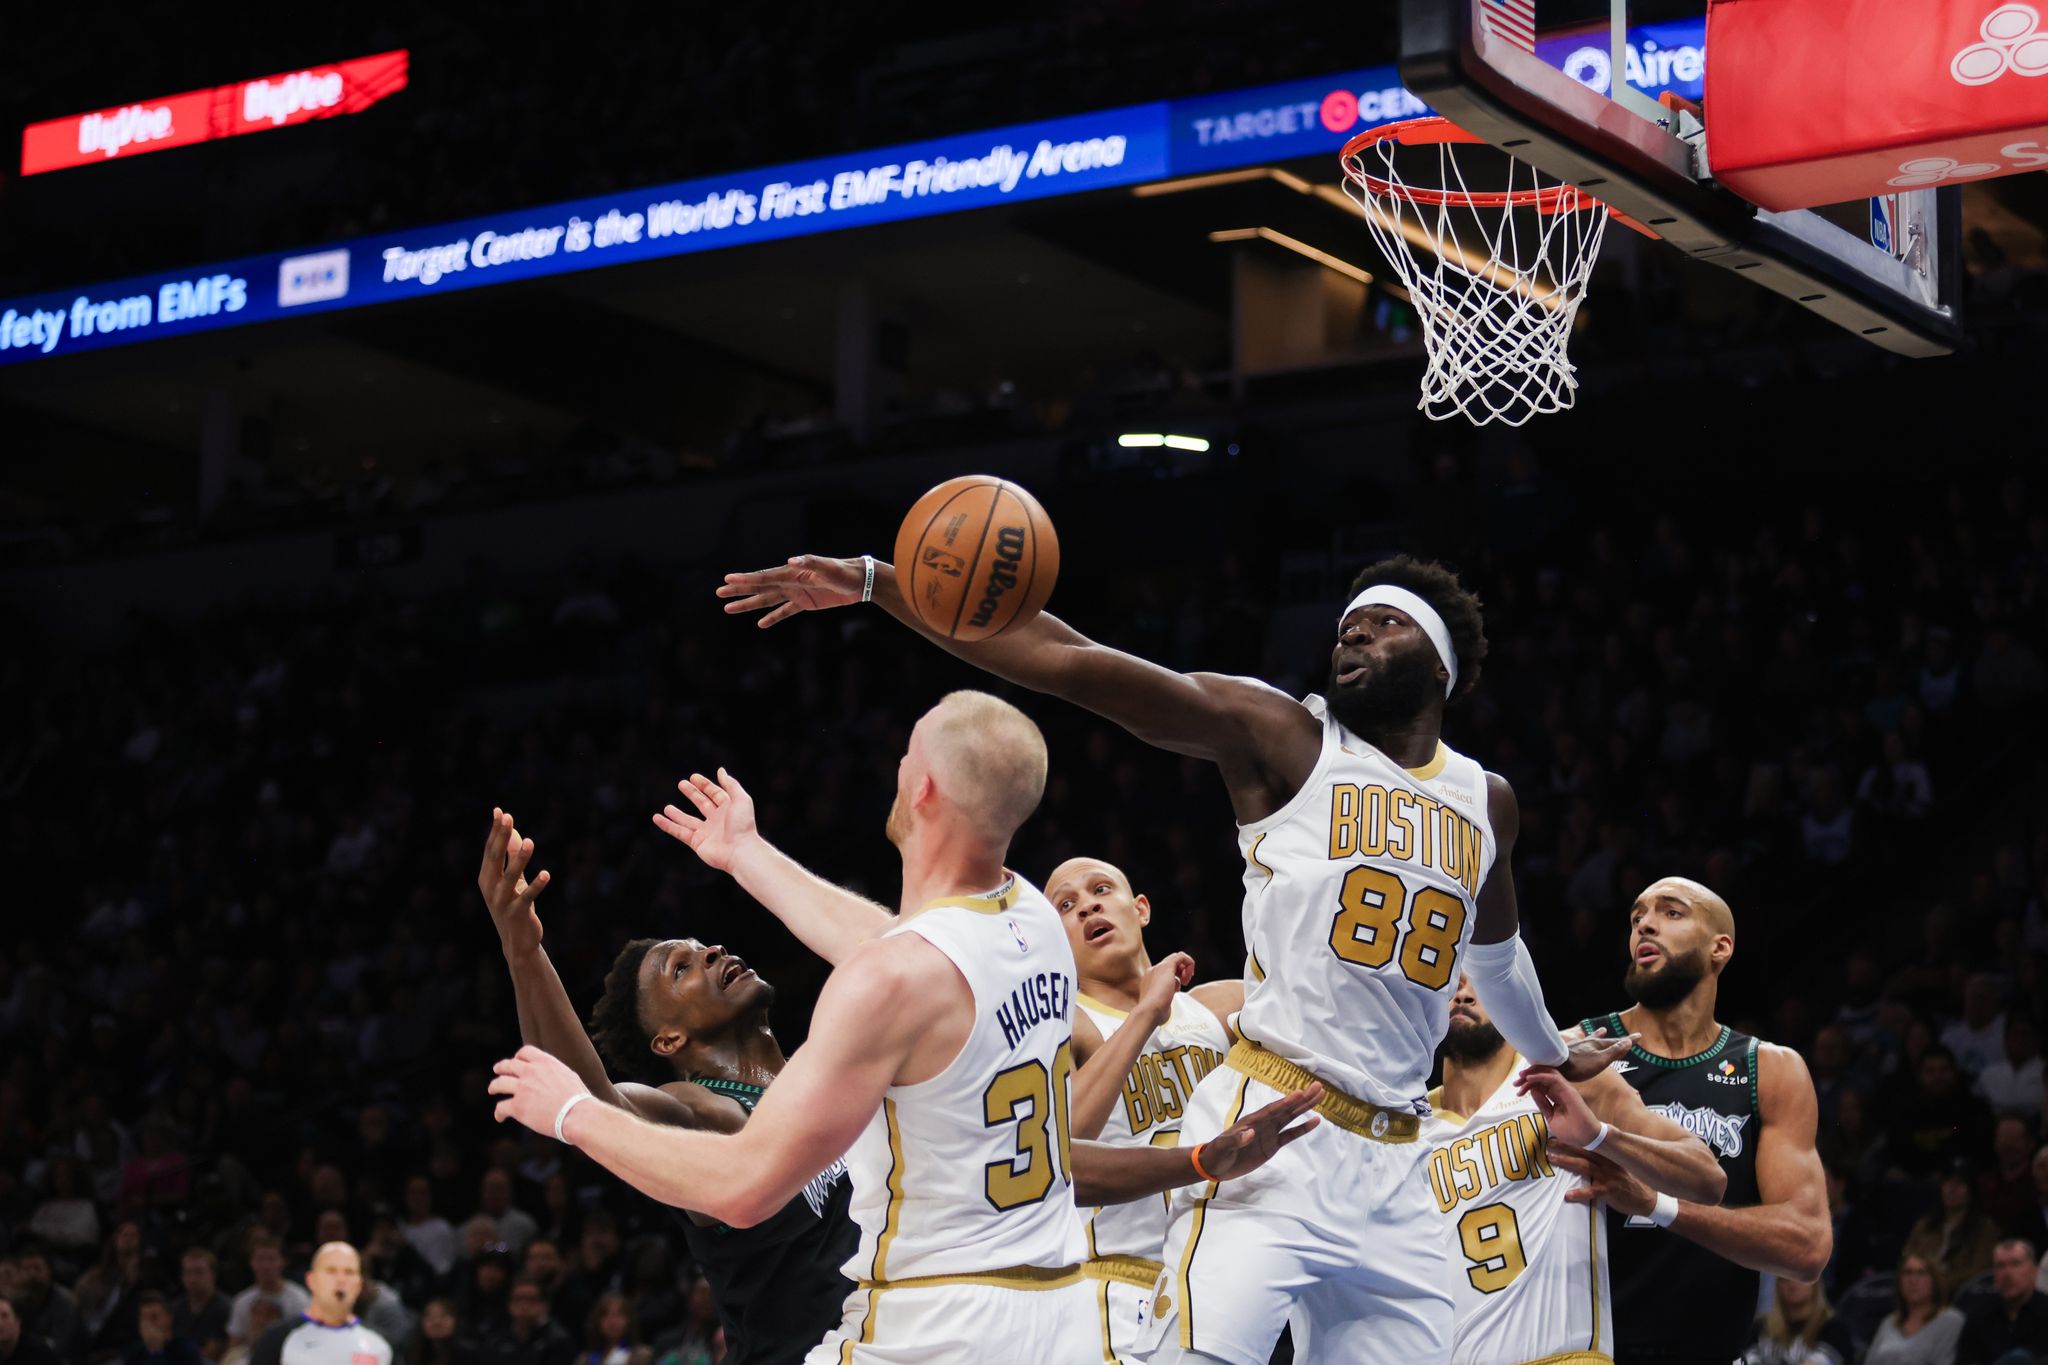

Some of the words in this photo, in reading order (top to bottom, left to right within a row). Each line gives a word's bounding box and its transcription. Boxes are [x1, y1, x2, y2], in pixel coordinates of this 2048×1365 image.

[1626, 40, 1706, 88] Aire
[1193, 101, 1317, 146] TARGET
[1358, 87, 1427, 121] CEN
[382, 238, 470, 285] Target
[470, 225, 565, 268] Center
[563, 216, 592, 252] is
[593, 208, 645, 248] the
[647, 189, 758, 239] World's
[759, 178, 829, 221] First
[829, 145, 1028, 211] EMF-Friendly
[1026, 135, 1127, 179] Arena
[70, 295, 152, 338] from
[157, 274, 247, 323] EMFs
[968, 527, 1025, 627] Wilson
[1328, 783, 1482, 901] BOSTON
[1328, 864, 1467, 992] 88
[996, 972, 1069, 1052] HAUSER
[1707, 1073, 1748, 1085] sezzle
[1428, 1113, 1555, 1213] OSTON
[1457, 1202, 1527, 1294] 9
